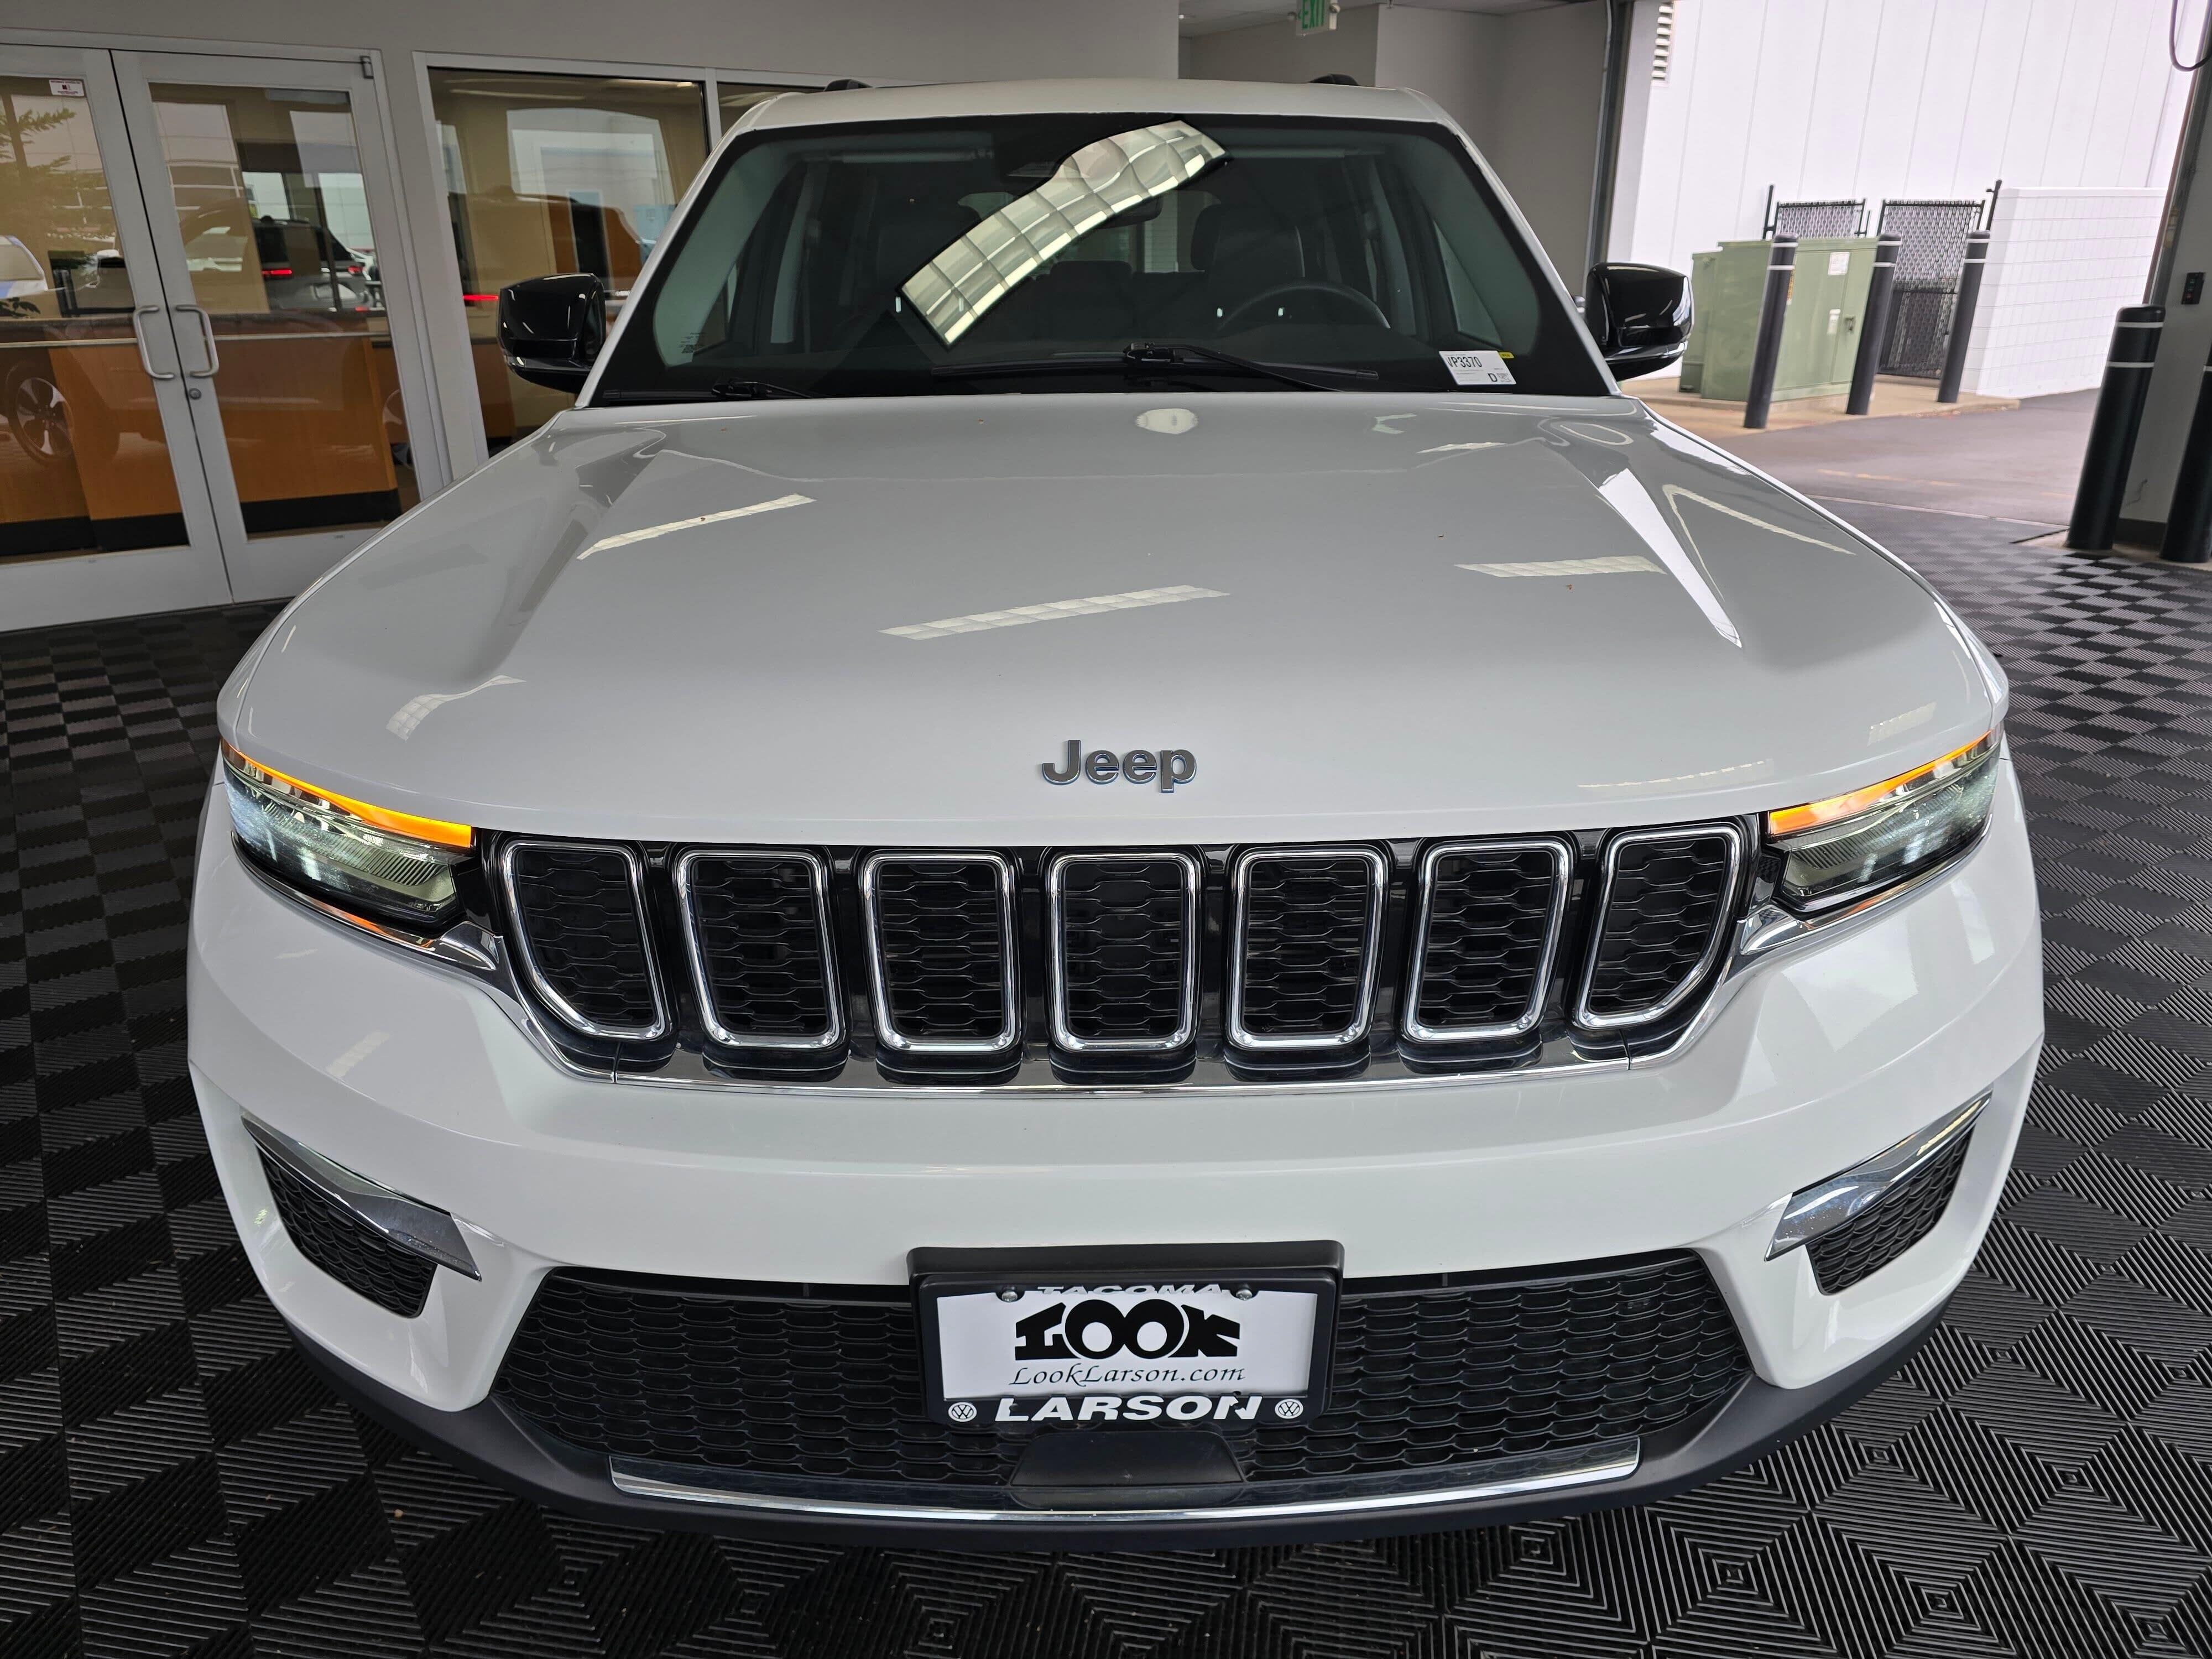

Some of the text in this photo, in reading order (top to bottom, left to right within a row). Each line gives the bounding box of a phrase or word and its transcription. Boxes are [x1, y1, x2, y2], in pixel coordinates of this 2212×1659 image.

[1302, 0, 1324, 29] EXIT
[1447, 356, 1483, 368] VP3370
[1488, 373, 1498, 382] D
[1042, 739, 1197, 793] Jeep
[1037, 1284, 1223, 1295] TACOMA
[1015, 1298, 1241, 1361] LOOK
[1008, 1362, 1247, 1387] LookLarson.com
[995, 1395, 1263, 1422] LARSON
